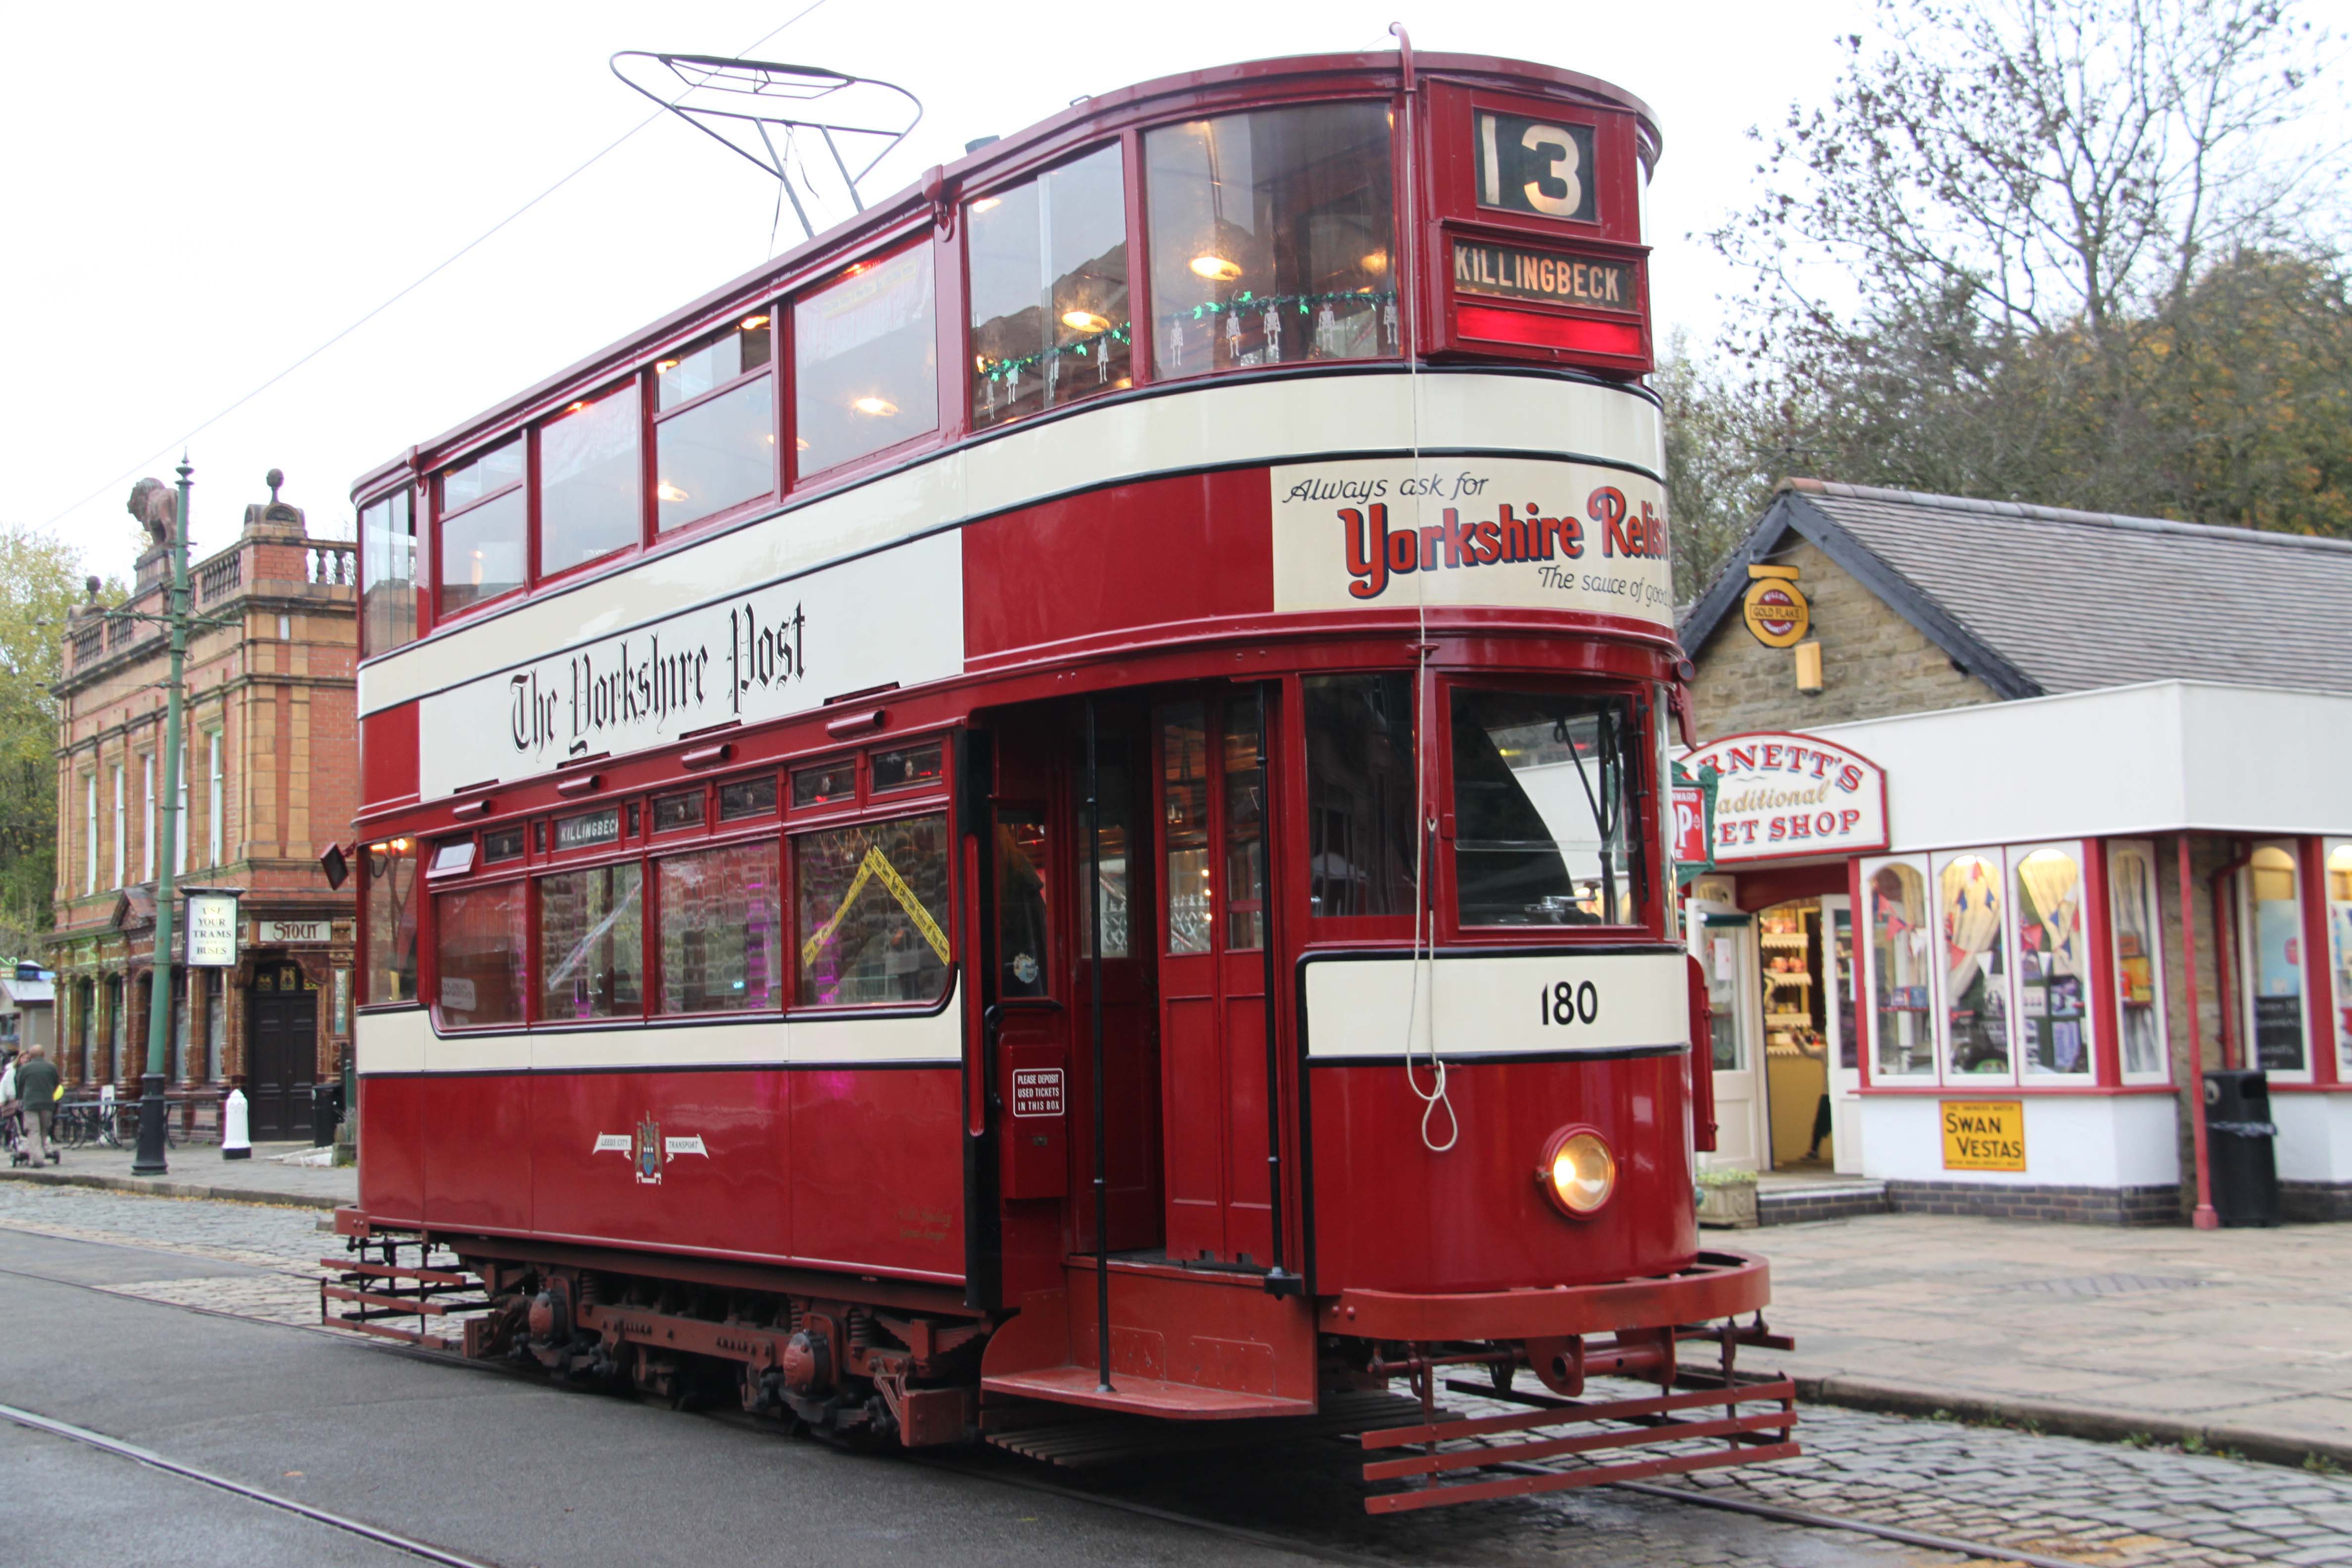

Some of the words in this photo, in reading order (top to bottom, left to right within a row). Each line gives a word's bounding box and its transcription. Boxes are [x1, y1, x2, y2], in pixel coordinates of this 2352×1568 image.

[1480, 114, 1582, 216] 13
[1455, 245, 1619, 302] KILLINGBECK
[1282, 478, 1388, 504] Always
[1400, 474, 1444, 496] ask
[1450, 472, 1489, 500] for
[1337, 502, 1584, 599] Yorkshire
[1538, 565, 1574, 589] The
[1581, 575, 1627, 595] sauce
[1630, 577, 1645, 603] of
[1753, 607, 1774, 617] GOLD
[1775, 608, 1800, 618] FLAKE
[510, 667, 558, 763] The
[569, 631, 709, 757] Yorkshire
[726, 599, 806, 717] Post
[1681, 744, 1864, 793] RNETT'S
[1713, 820, 1759, 847] ET
[1767, 809, 1861, 843] SHOP
[202, 907, 224, 915] USE
[273, 922, 321, 940] STOUT
[196, 946, 227, 955] BUSES
[1541, 980, 1598, 1026] 180
[1018, 1075, 1036, 1084] PLEASE
[1038, 1074, 1059, 1084] DEPOSIT
[1018, 1088, 1033, 1098] USED
[1035, 1087, 1059, 1097] TICKETS
[1018, 1101, 1026, 1111] IN
[1028, 1101, 1044, 1111] THIS
[1046, 1100, 1060, 1110] BOX
[1946, 1113, 2001, 1133] SWAN
[668, 1140, 699, 1149] TRANSPORT
[1957, 1136, 2021, 1159] VESTAS
